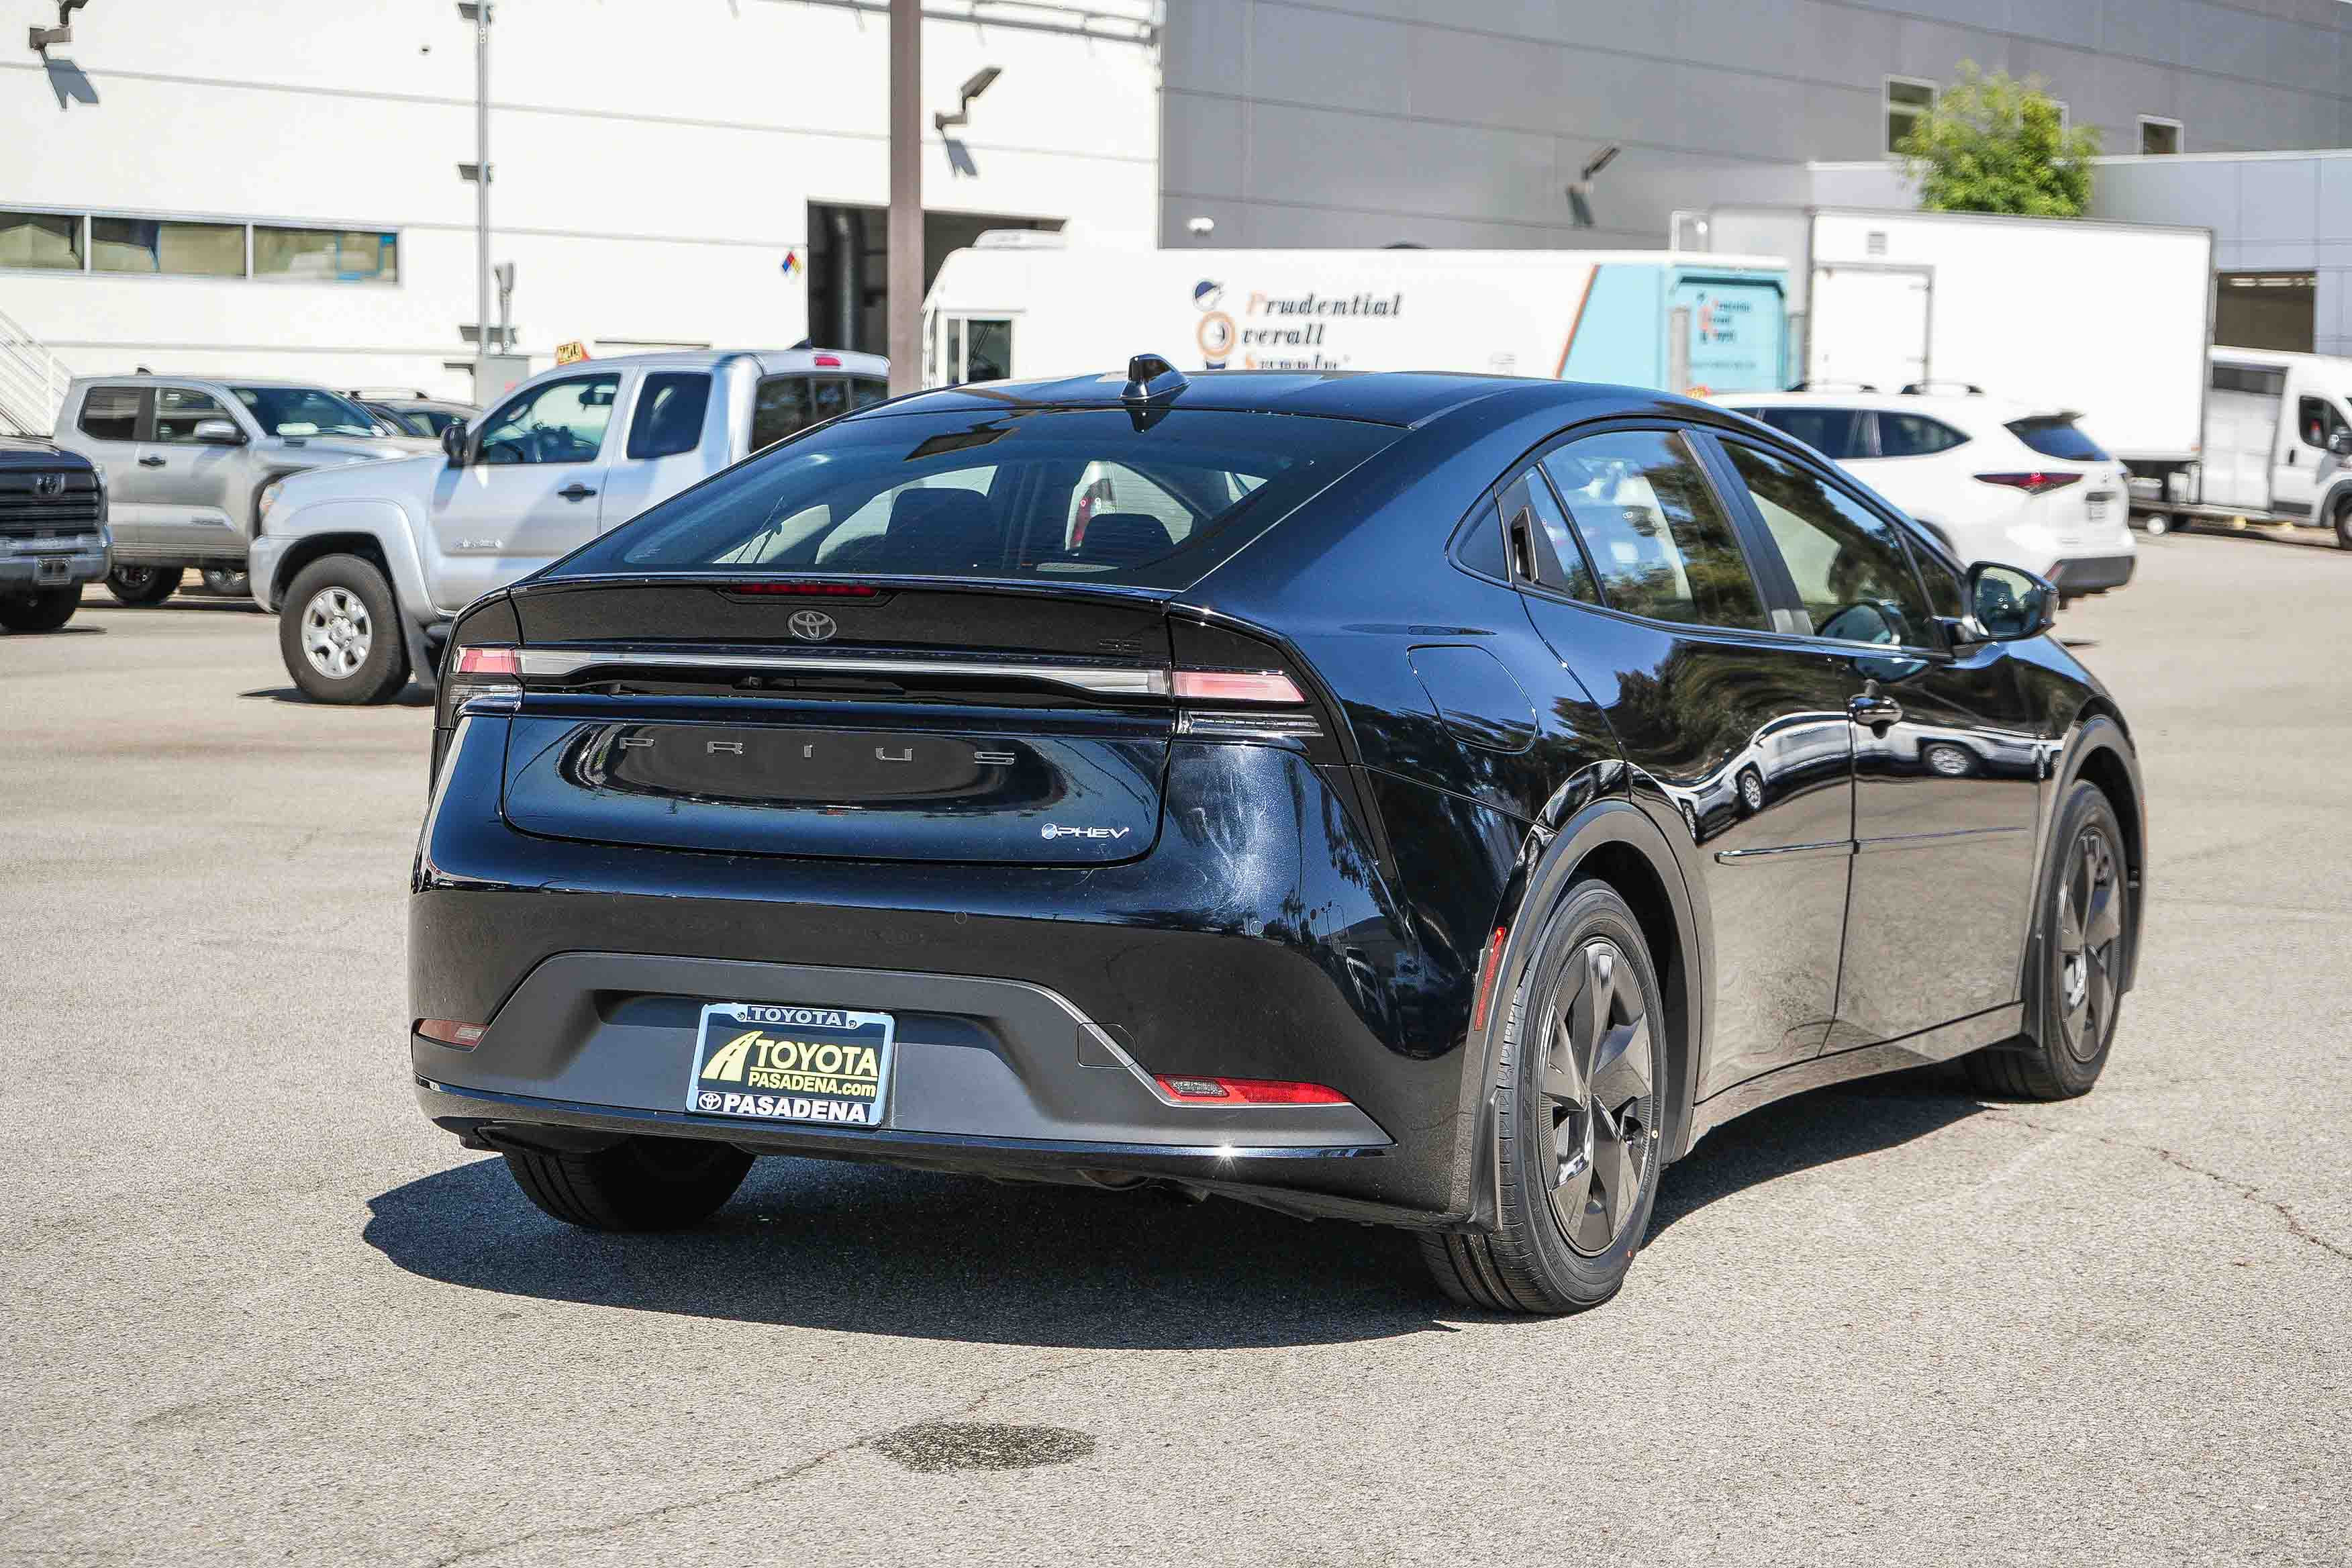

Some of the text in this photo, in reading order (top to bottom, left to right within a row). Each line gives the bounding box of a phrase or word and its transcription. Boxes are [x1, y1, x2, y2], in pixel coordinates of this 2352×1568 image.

[1246, 290, 1403, 315] Prudential
[619, 738, 1015, 765] PRIUS
[751, 1007, 842, 1026] TOYOTA
[755, 1039, 879, 1077] TOYOTA
[748, 1071, 877, 1097] PASADENA.com
[723, 1094, 867, 1123] PASADENA
